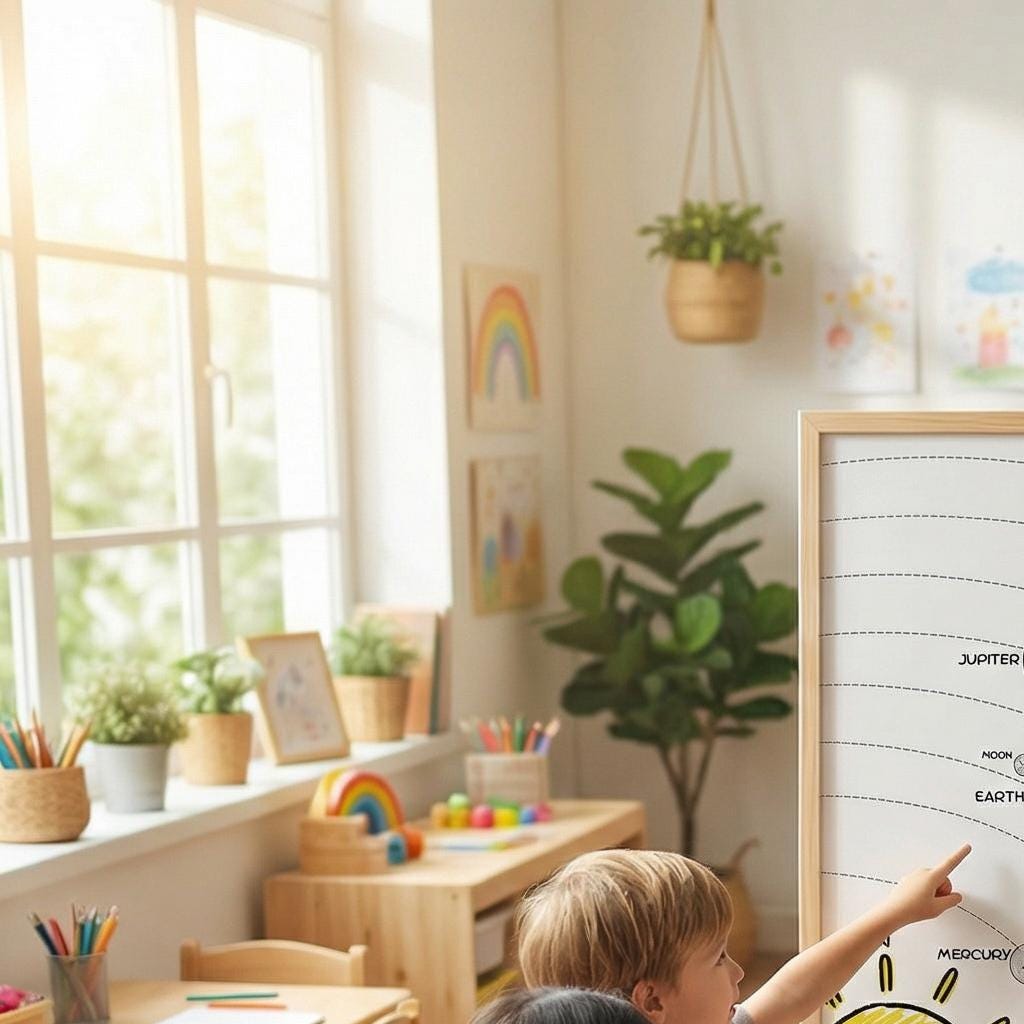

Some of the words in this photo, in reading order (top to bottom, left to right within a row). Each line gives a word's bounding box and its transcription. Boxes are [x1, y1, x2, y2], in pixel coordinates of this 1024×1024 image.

[957, 653, 1020, 666] JUPITER
[974, 790, 1024, 803] EARTH
[937, 947, 1012, 962] MERCURY
